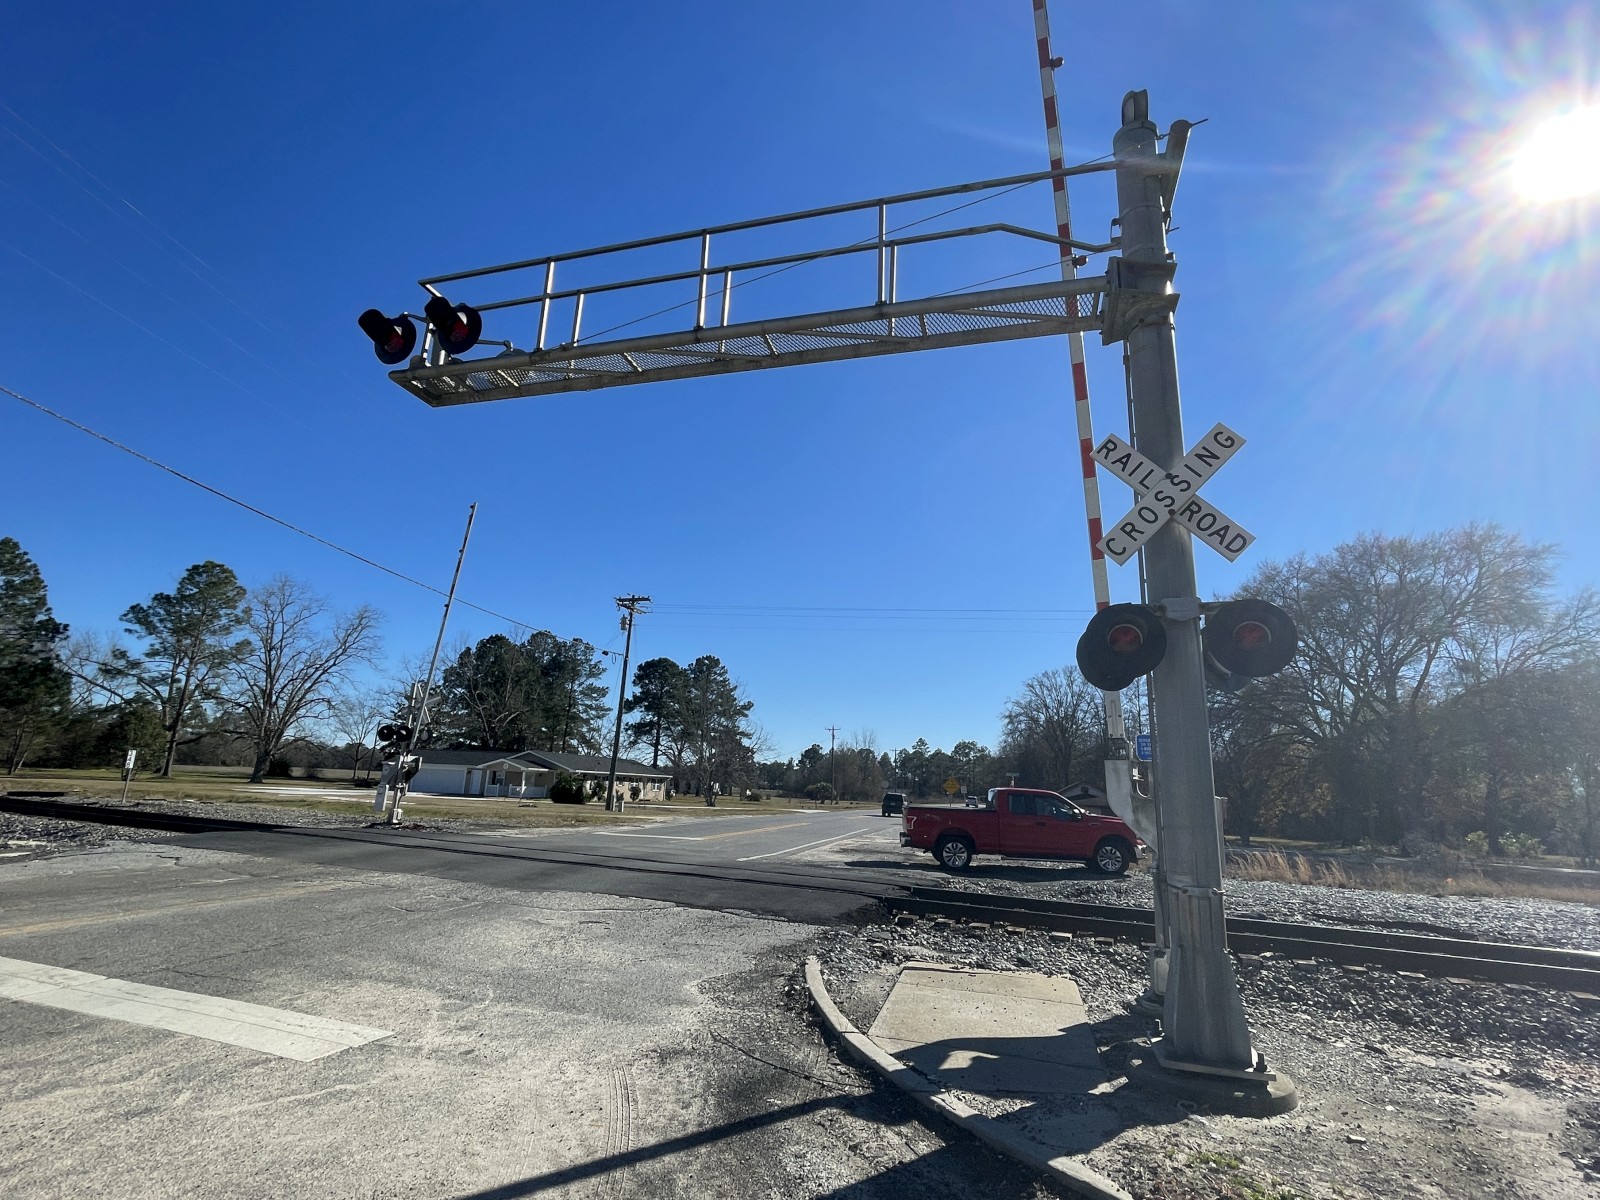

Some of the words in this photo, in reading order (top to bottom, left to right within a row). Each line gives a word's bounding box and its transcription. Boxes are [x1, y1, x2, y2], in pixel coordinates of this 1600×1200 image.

[1097, 439, 1155, 490] RAIL
[1180, 500, 1247, 554] ROAD
[1106, 431, 1235, 556] CROSSING
